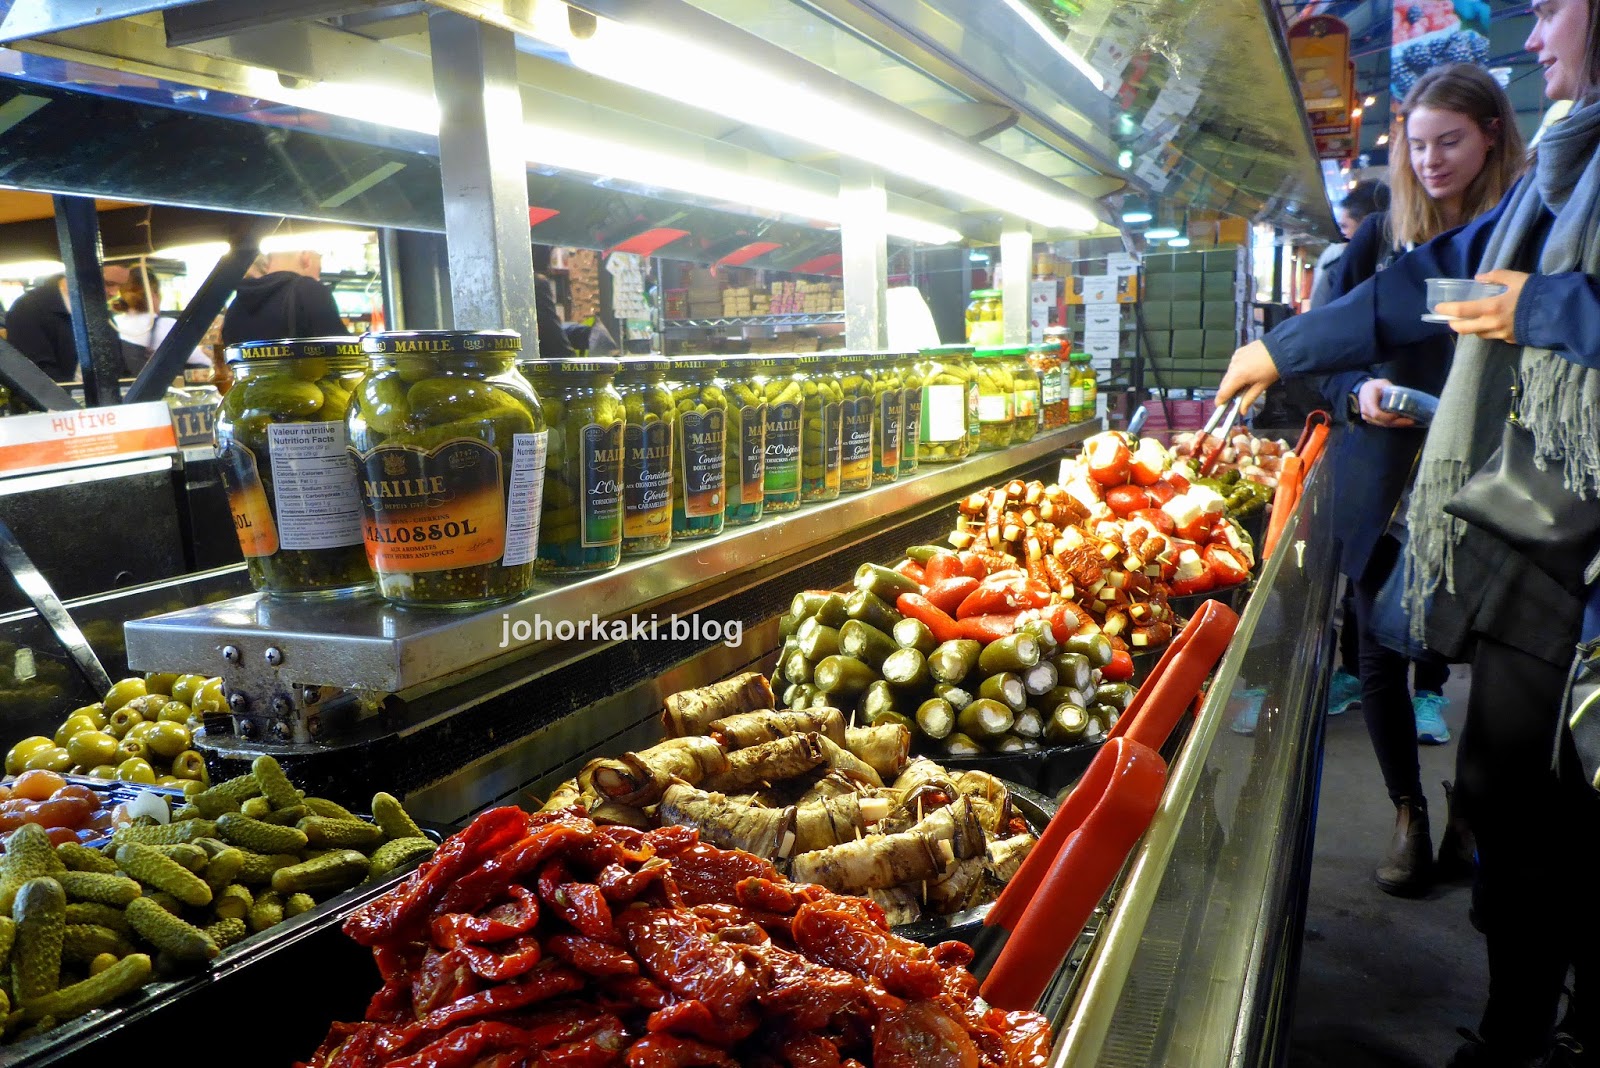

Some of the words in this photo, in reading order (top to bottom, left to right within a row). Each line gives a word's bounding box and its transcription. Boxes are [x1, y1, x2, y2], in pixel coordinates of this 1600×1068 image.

[273, 428, 298, 436] Valeur
[301, 426, 335, 435] nutritive
[273, 437, 310, 446] Nutrition
[312, 435, 335, 444] Facts
[363, 475, 446, 498] MAILLE
[402, 544, 437, 553] AROMATES
[415, 551, 430, 559] AND
[431, 548, 455, 556] SPICES
